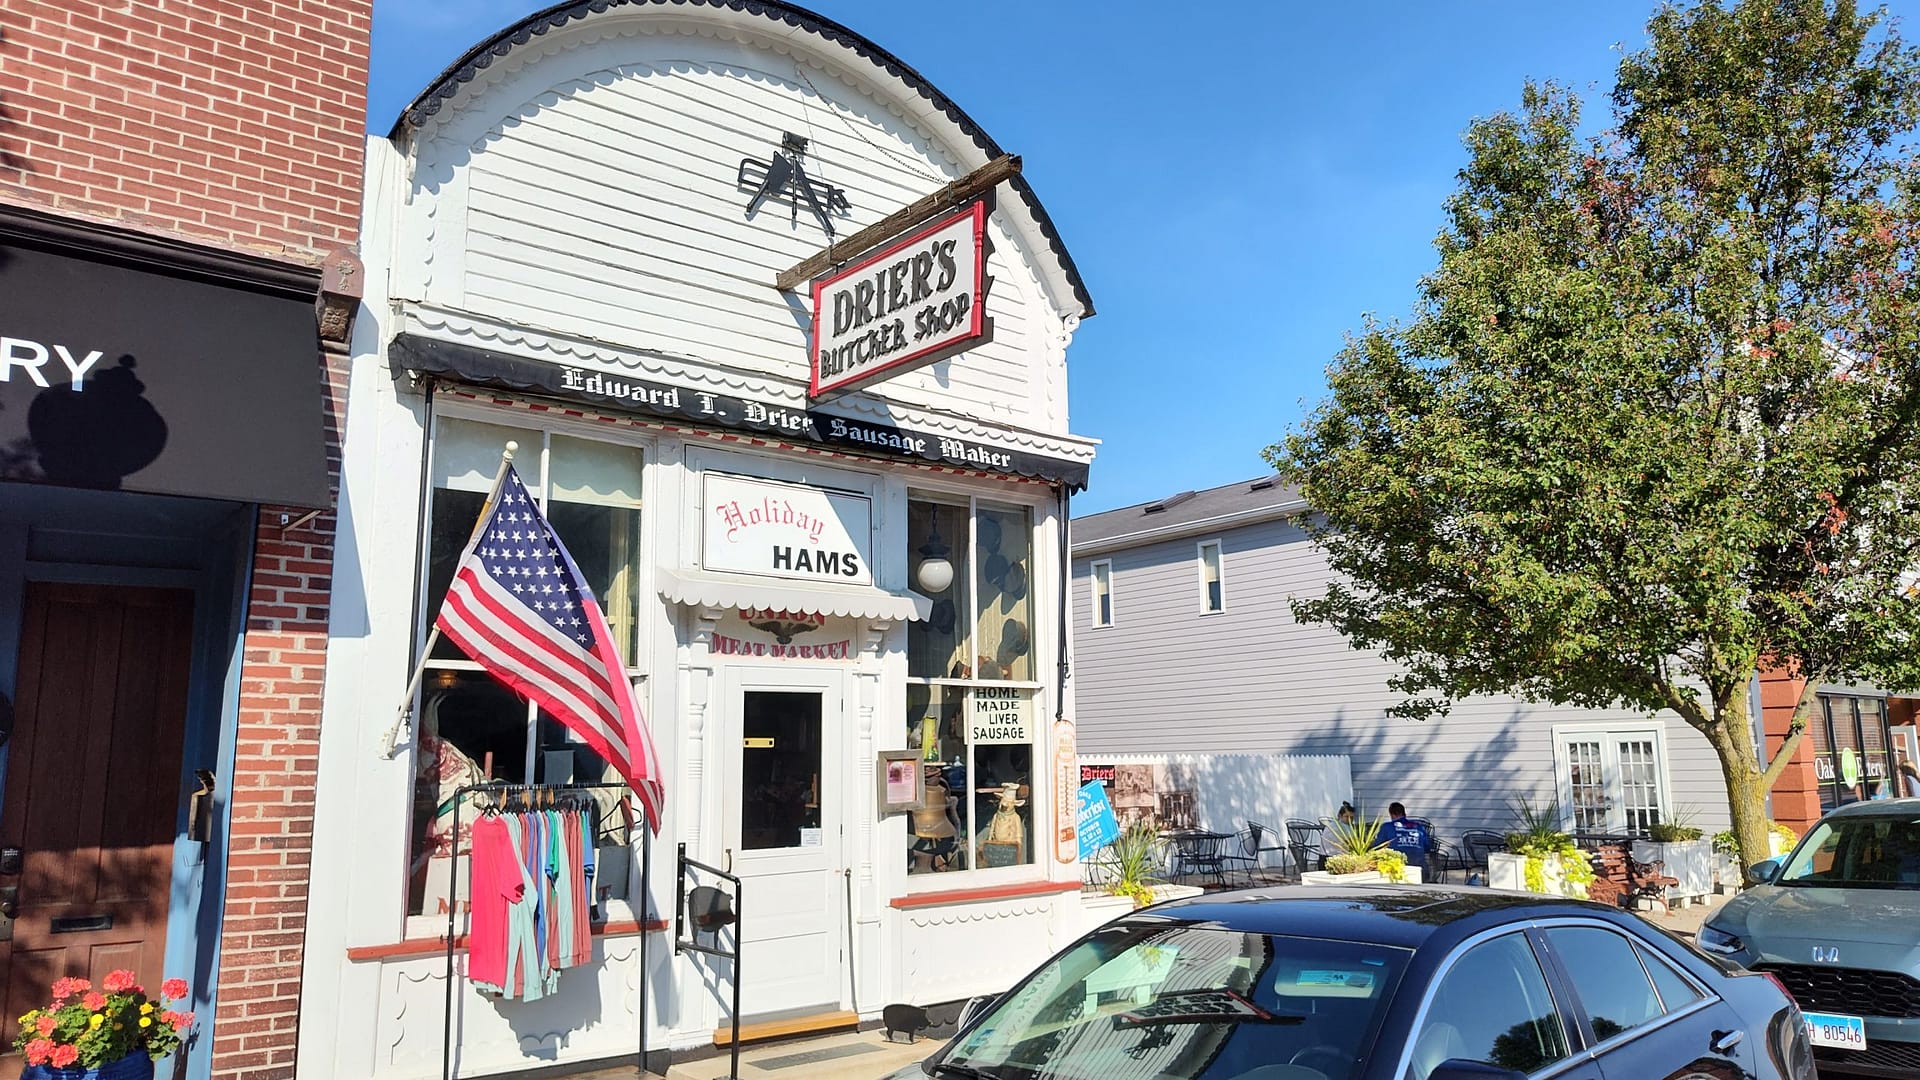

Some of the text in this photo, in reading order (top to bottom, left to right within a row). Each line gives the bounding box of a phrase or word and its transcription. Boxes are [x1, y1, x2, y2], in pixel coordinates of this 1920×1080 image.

[832, 239, 957, 338] DRIER'S
[820, 292, 970, 379] BUTCHER SHOP
[0, 336, 104, 392] RY
[559, 365, 680, 409] Edward
[742, 400, 814, 433] Drier
[829, 418, 926, 454] Sausage
[937, 436, 1011, 468] Maker
[715, 495, 826, 545] Holiday
[772, 545, 859, 577] HAMS
[711, 632, 850, 659] MEAT MARKET
[976, 687, 1020, 698] HOME
[976, 700, 1020, 712] MADE
[989, 713, 1018, 725] LIVER
[973, 726, 1025, 740] SAUSAGE
[1081, 766, 1115, 780] Driers
[1814, 757, 1836, 780] Oak
[1823, 1024, 1862, 1044] 80546
